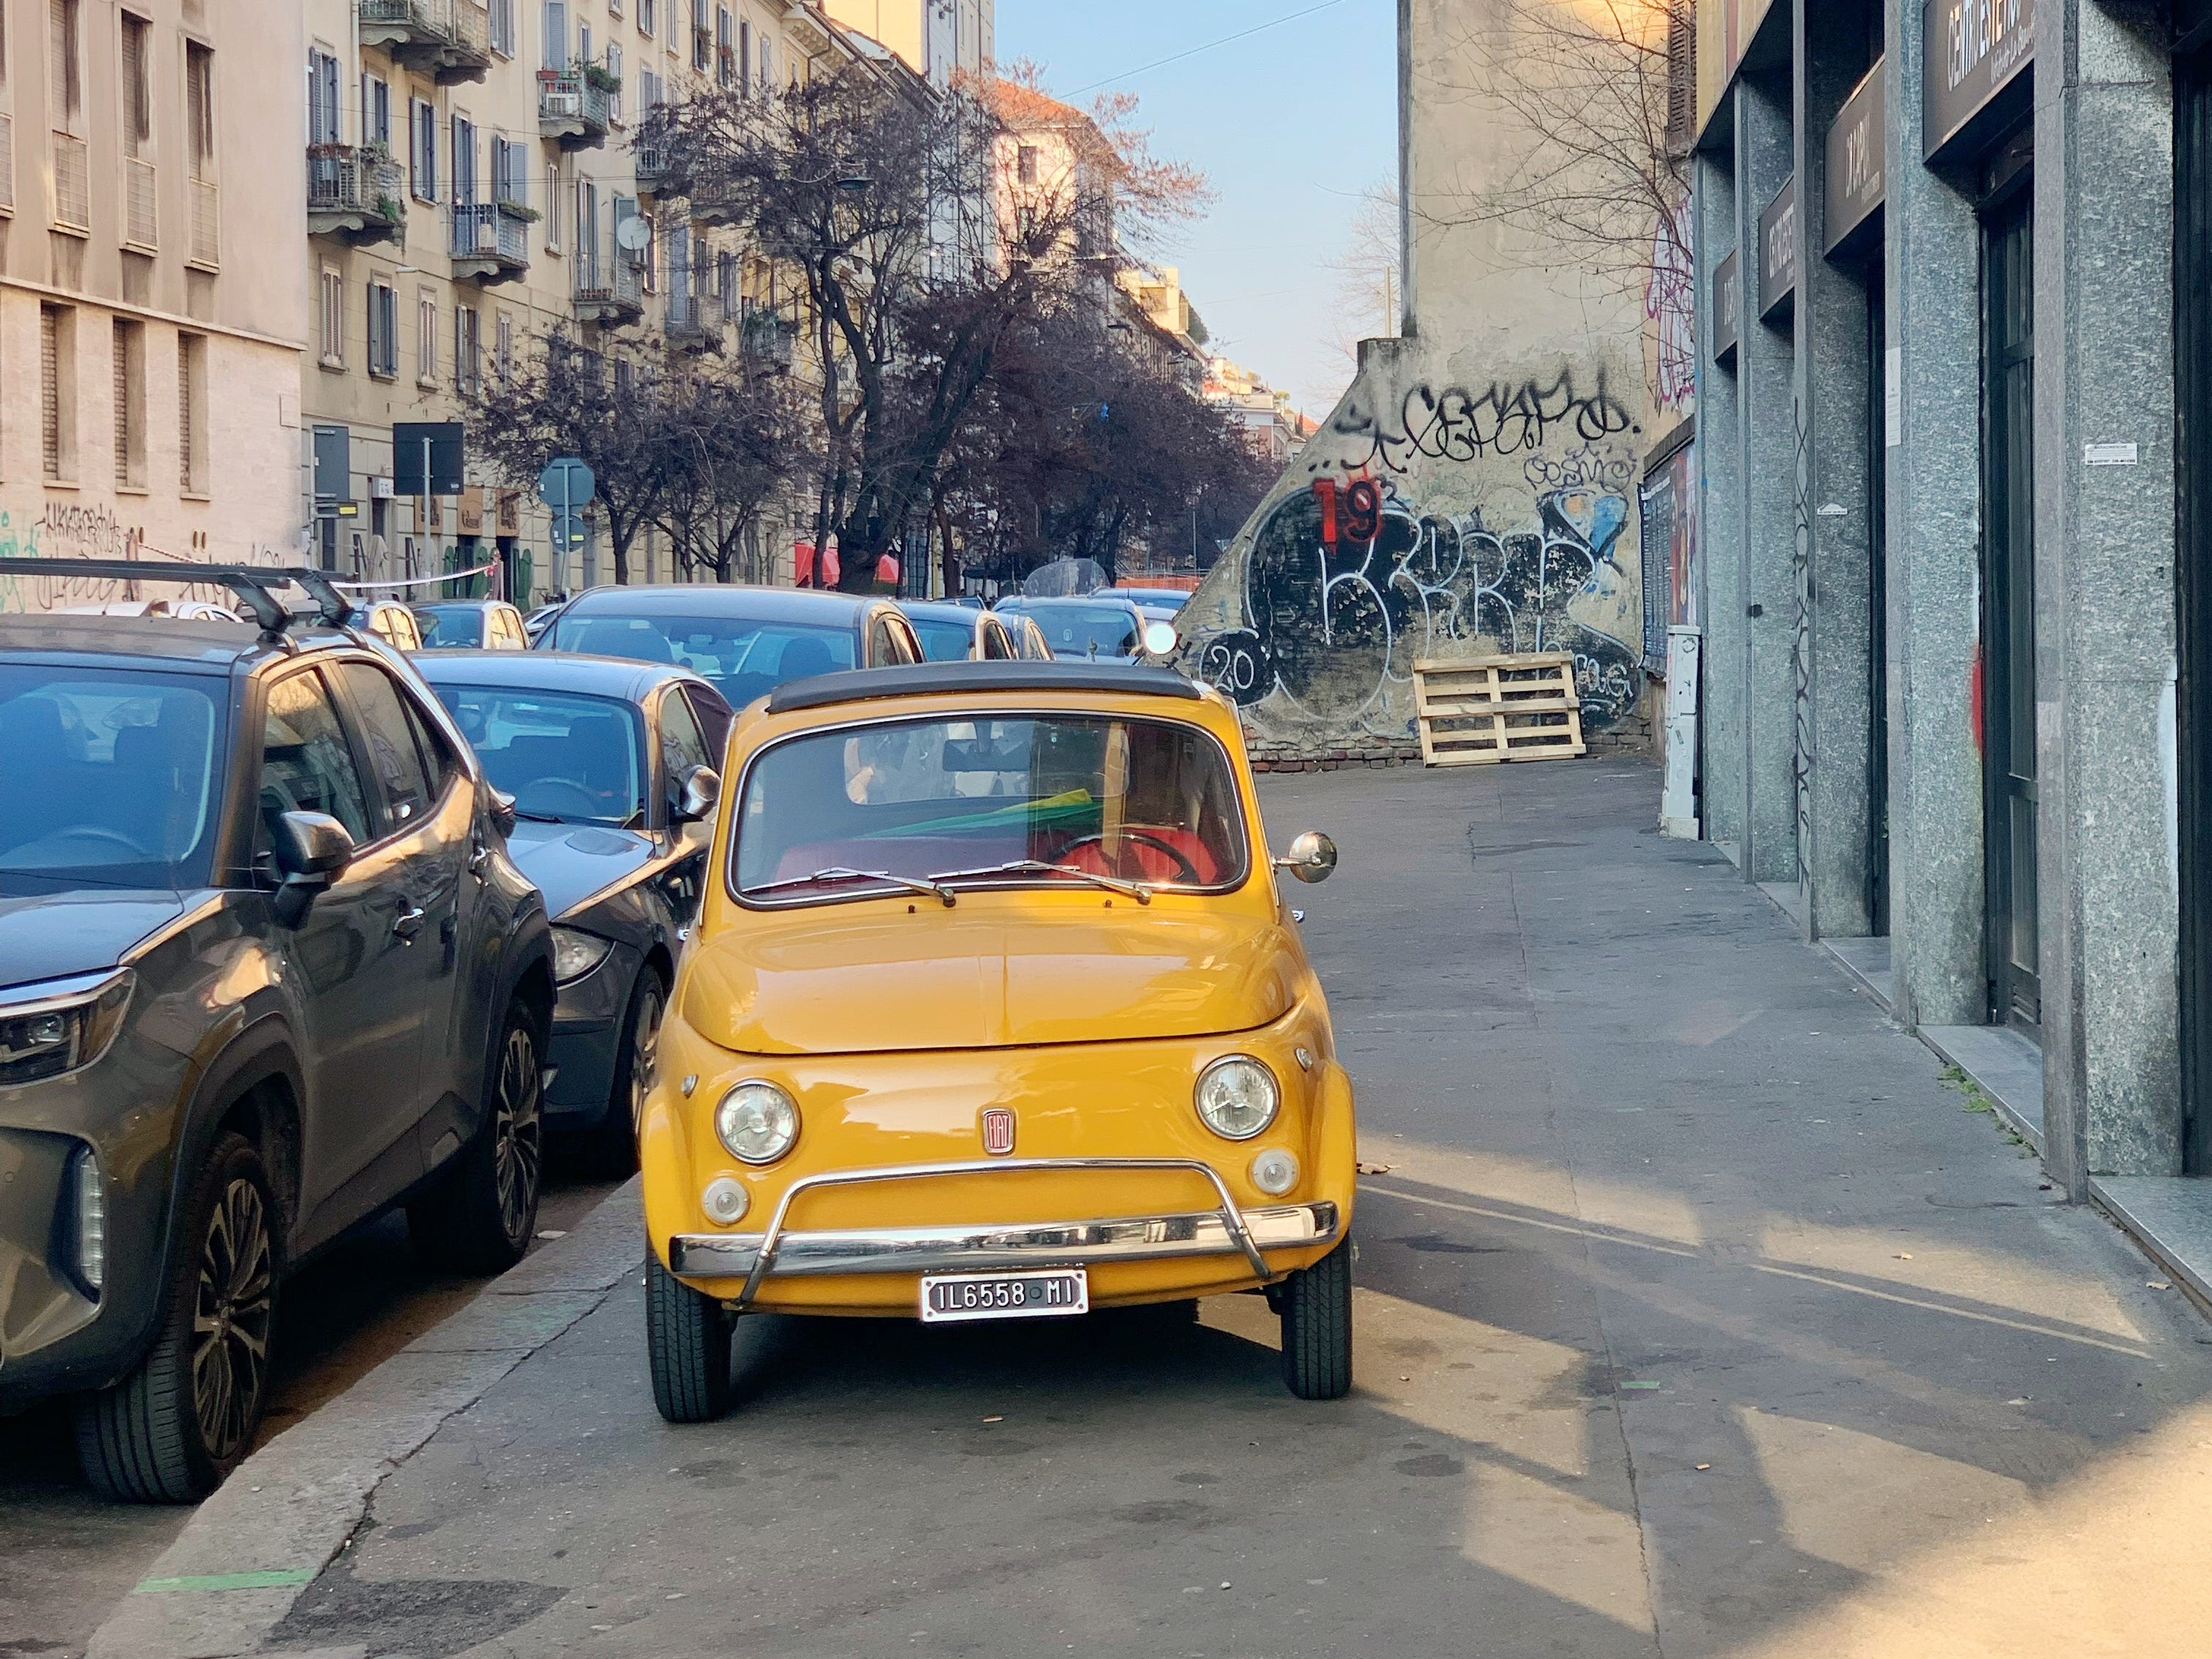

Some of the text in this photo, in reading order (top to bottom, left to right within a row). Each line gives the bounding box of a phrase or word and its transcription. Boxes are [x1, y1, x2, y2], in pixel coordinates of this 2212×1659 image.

[1312, 477, 1382, 543] 19
[1211, 645, 1254, 693] 20
[987, 1114, 1009, 1148] FIAT
[938, 1279, 1073, 1309] 1L6558 MI
